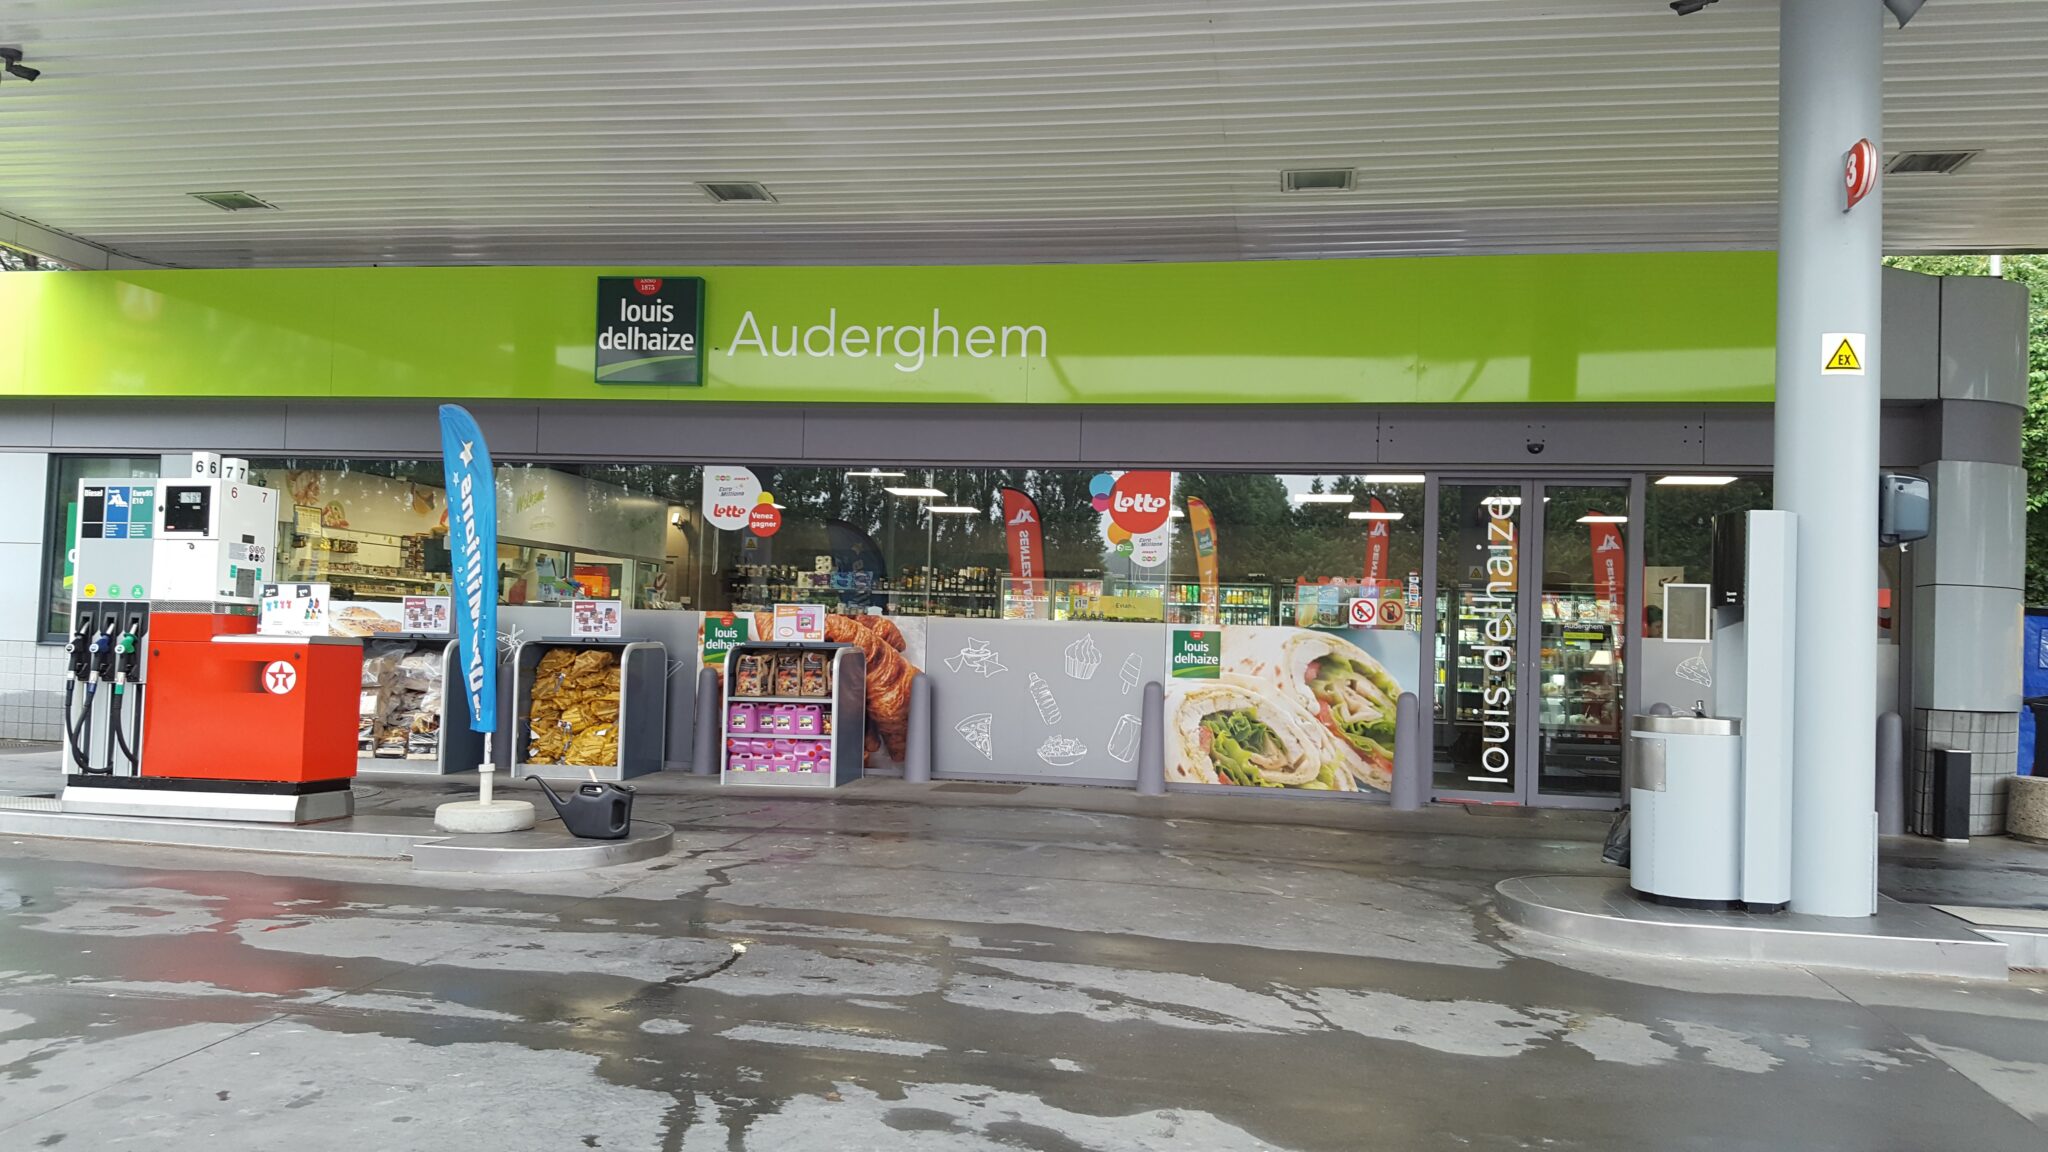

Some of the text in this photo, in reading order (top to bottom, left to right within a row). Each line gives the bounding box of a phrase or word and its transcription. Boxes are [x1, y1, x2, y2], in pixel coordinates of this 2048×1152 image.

[1846, 153, 1857, 188] 3
[621, 298, 674, 322] louis
[598, 326, 694, 351] delhaize
[727, 308, 1047, 372] Auderghem
[1838, 354, 1851, 367] EX
[196, 460, 204, 473] 6
[210, 462, 216, 474] 6
[226, 466, 233, 478] 7
[239, 468, 245, 479] 7
[231, 487, 238, 498] 6
[262, 492, 267, 503] 7
[751, 521, 777, 529] gagner
[715, 628, 737, 638] louis
[1564, 623, 1604, 631] Auderghem
[1467, 496, 1515, 783] louis delhaize
[1184, 640, 1209, 652] louis
[1174, 652, 1219, 665] delhaize
